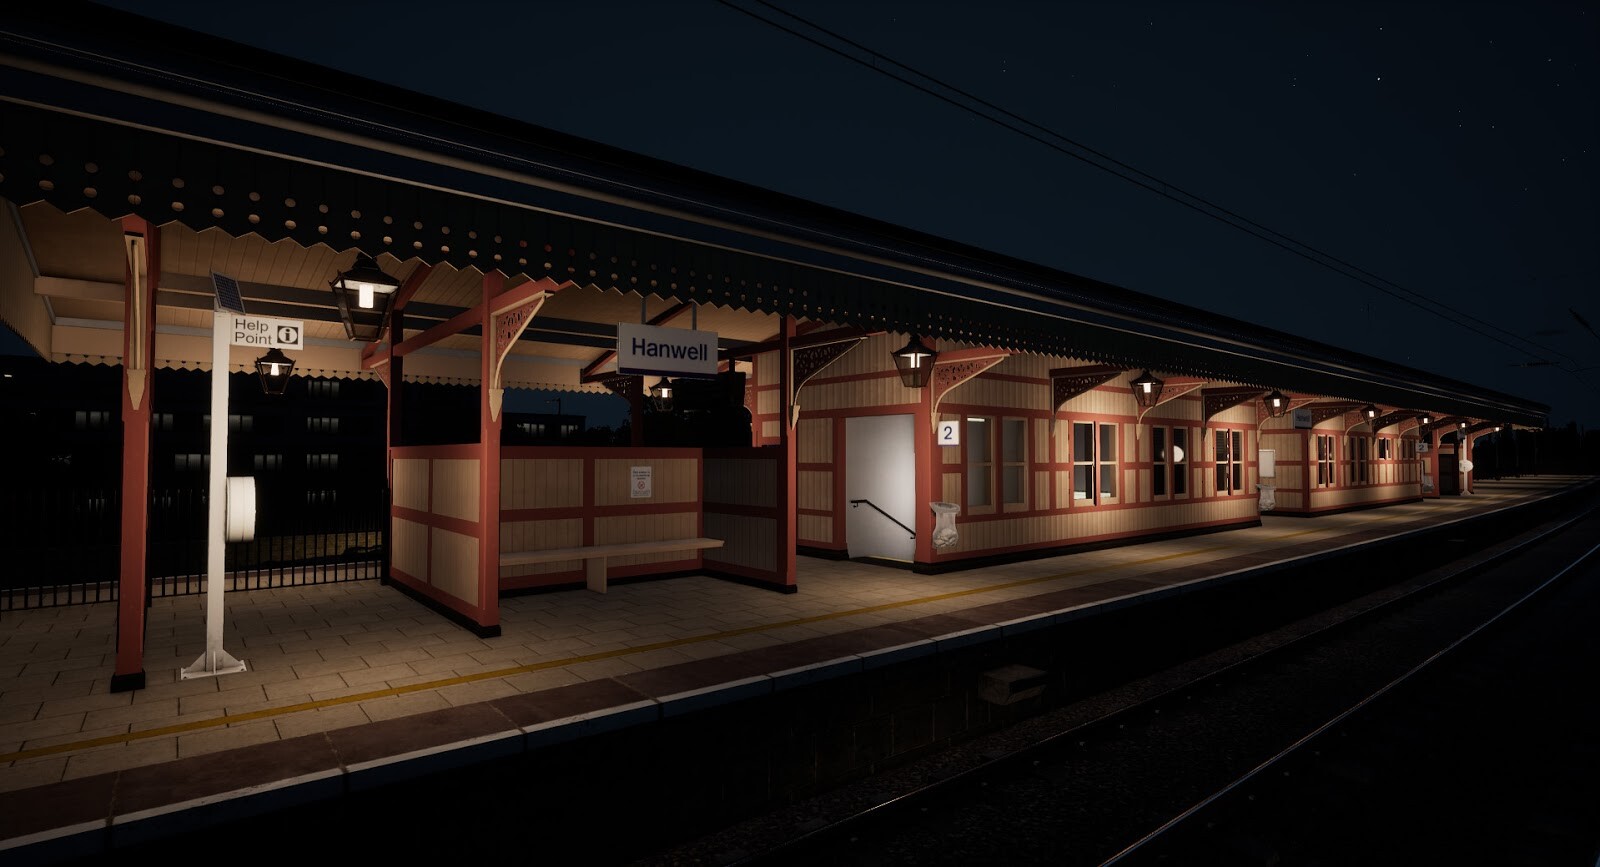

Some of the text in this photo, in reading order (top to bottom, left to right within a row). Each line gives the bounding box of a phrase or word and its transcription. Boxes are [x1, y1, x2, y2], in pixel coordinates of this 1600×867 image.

[235, 318, 268, 332] Help
[235, 331, 272, 345] Point
[632, 337, 707, 361] Hanwell
[943, 425, 952, 440] 2
